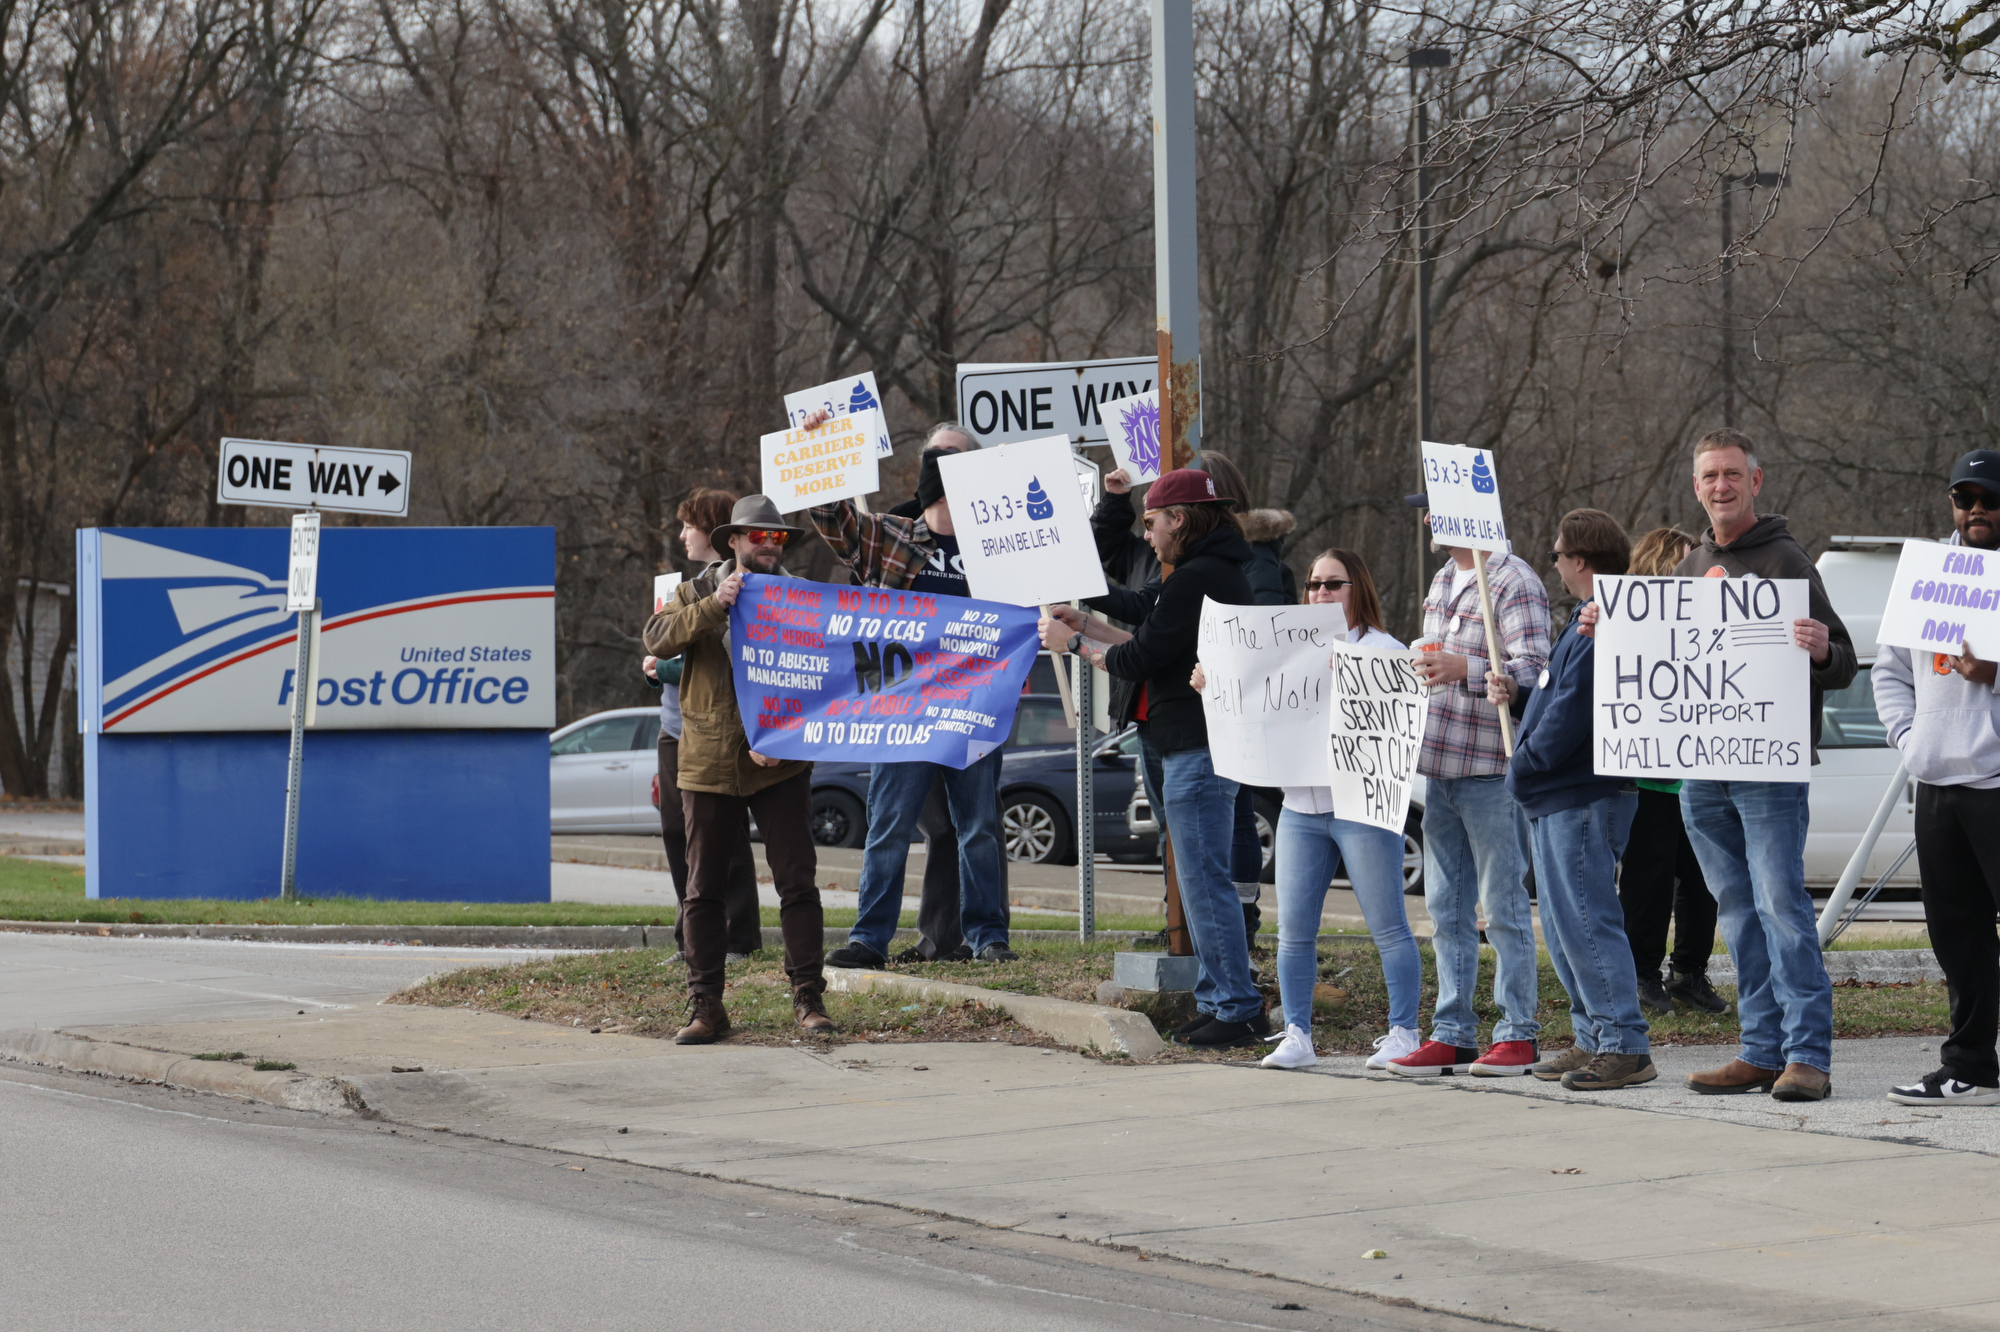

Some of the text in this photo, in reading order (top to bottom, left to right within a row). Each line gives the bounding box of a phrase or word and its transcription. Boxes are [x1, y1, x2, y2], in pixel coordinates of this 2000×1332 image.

[969, 386, 1054, 435] ONE
[785, 417, 853, 446] LETTER
[773, 432, 866, 466] CARRIERS
[227, 454, 374, 498] ONE WAY
[779, 451, 862, 483] DESERVE
[794, 473, 846, 498] MORE
[970, 499, 990, 525] 1.3
[1002, 495, 1014, 519] 3
[293, 526, 317, 556] ENTER
[981, 526, 1061, 557] BRIAN BE LIE-N
[1431, 514, 1505, 541] BRIAN BE LIE-N
[927, 570, 948, 578] WORTH
[1942, 552, 1985, 577] FAIR
[293, 566, 312, 597] ONLY
[763, 584, 823, 608] NO MORE
[1910, 579, 2000, 611] CONTRACT
[837, 589, 938, 618] NO TO 1.3%
[1598, 578, 1781, 623] VOTE NO
[755, 604, 823, 628] IGNORING
[827, 614, 928, 643] NO TO CCAS
[960, 609, 1000, 624] NO TO
[746, 623, 825, 649] USPS HEROES
[944, 621, 1001, 642] UNIFORM
[1223, 615, 1263, 650] The
[1670, 627, 1726, 662] 1.3%
[1921, 618, 1966, 645] NOW
[400, 646, 532, 663] United States
[742, 644, 830, 673] NO TO ABUSIVE
[914, 652, 932, 666] NO
[939, 636, 1001, 659] MONOPOLY
[747, 665, 823, 691] MANAGEMENT
[852, 641, 914, 694] NO
[1615, 654, 1747, 701] HONK
[391, 667, 529, 705] Office
[1210, 668, 1321, 717] Hell No!!
[763, 695, 803, 713] NO TO
[823, 698, 849, 716] NO
[868, 694, 914, 716] TABLE
[913, 697, 930, 715] 2
[925, 705, 997, 728] NO TO BREAKING
[1602, 701, 1775, 729] TO SUPPORT
[803, 721, 935, 745] NO TO DIET COLAS
[1340, 698, 1422, 743] SERVICE!
[1331, 733, 1384, 777] FIRST
[1602, 733, 1801, 770] MAIL CARRIERS
[1363, 776, 1402, 827] PAY!!!
